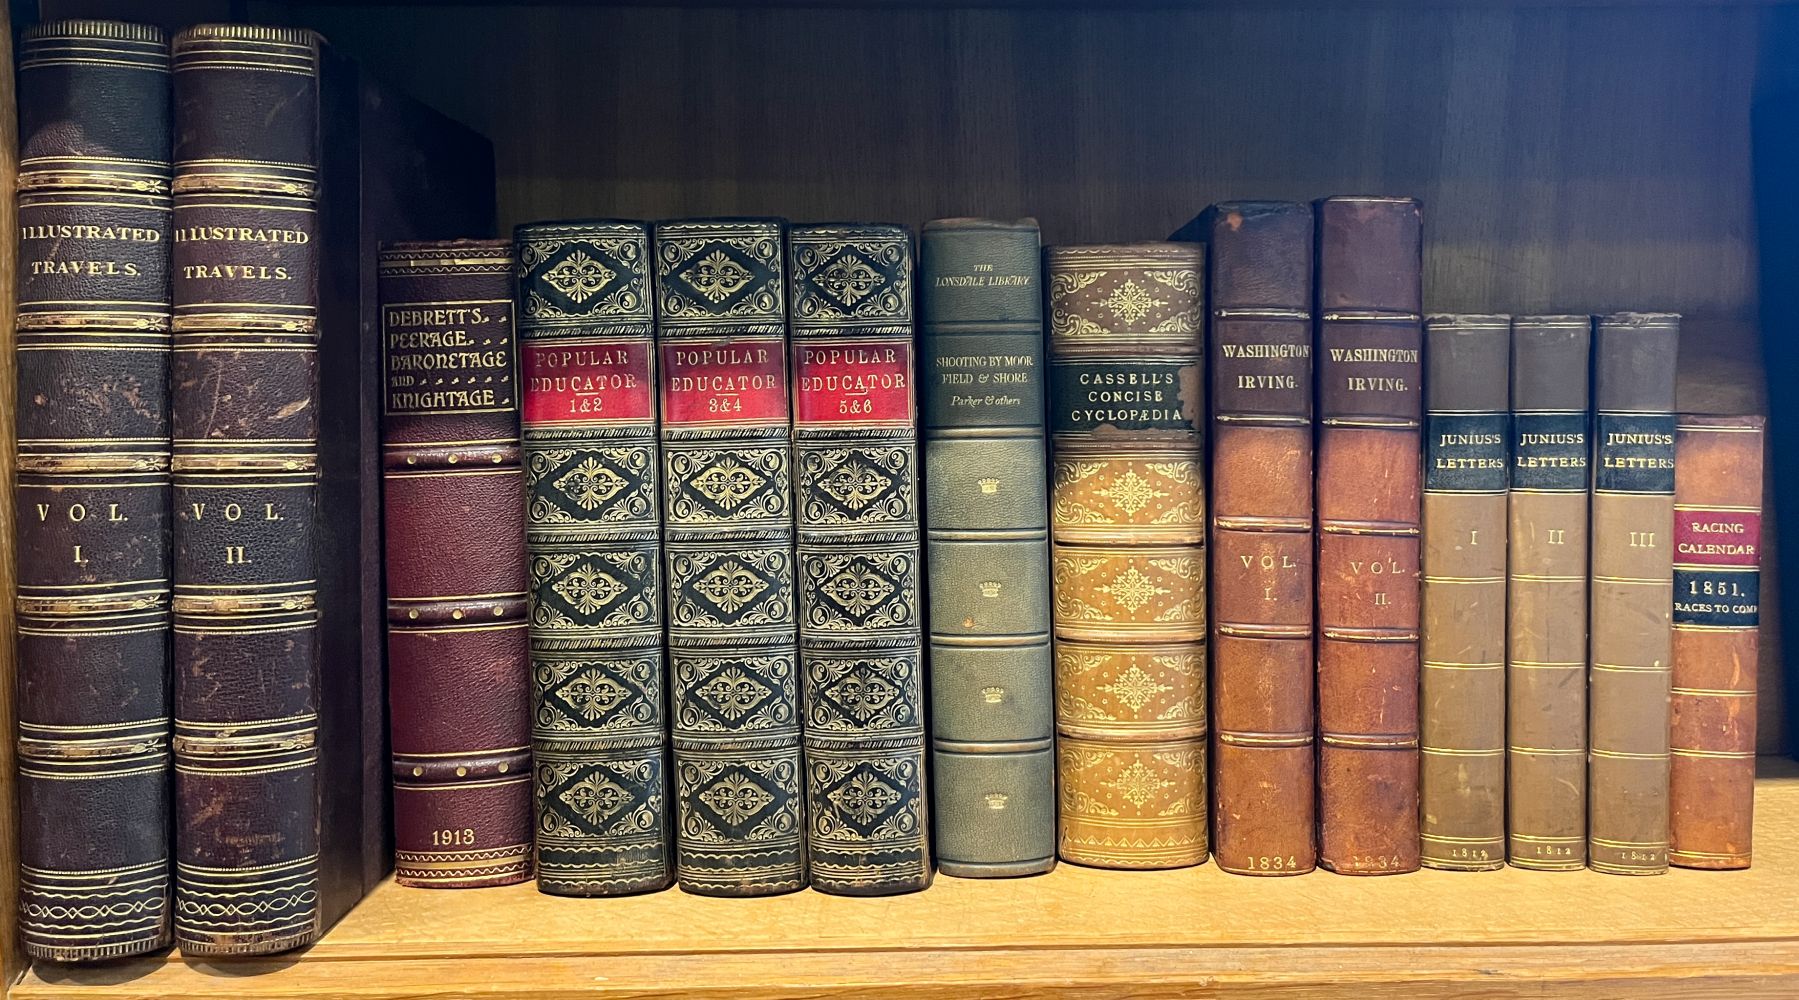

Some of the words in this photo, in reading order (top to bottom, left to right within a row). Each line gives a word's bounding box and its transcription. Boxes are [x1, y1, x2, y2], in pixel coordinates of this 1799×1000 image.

[22, 224, 161, 243] ILLUSTRATED
[175, 225, 310, 244] ILLUSTRATED
[31, 260, 142, 277] TRAVELS.
[183, 265, 292, 281] TRAVELS.
[973, 264, 994, 272] THE
[935, 275, 985, 287] LONSDALE
[988, 275, 1031, 287] LIBRARY
[389, 307, 482, 327] DEBRETT'S
[390, 330, 467, 349] PEERAGE
[535, 350, 628, 368] POPULAR
[676, 349, 769, 366] POPULAR
[804, 348, 897, 365] POPULAR
[1222, 344, 1310, 359] WASHINGTON
[1329, 348, 1419, 363] WASHINGTON
[391, 351, 507, 370] BARONETAGE
[936, 355, 987, 368] SHOOTING
[989, 355, 1001, 366] BY
[1004, 355, 1034, 366] MOOR
[391, 375, 415, 388] AND
[530, 373, 637, 392] EDUCATOR
[671, 374, 776, 392] EDUCATOR
[801, 373, 906, 392] EDUCATOR
[942, 373, 974, 384] FIELD
[978, 373, 989, 383] &
[993, 372, 1028, 383] SHORE
[1079, 373, 1174, 385] CASSELL'S
[1237, 375, 1299, 389] IRVING.
[1347, 377, 1409, 392] IRVING.
[392, 389, 495, 409] KNIGHTAGE
[951, 395, 983, 408] Parker
[985, 395, 994, 406] &
[995, 395, 1021, 406] others
[1088, 390, 1163, 402] CONCISE
[569, 397, 603, 413] 1&2
[708, 398, 742, 413] 3&4
[839, 398, 872, 414] 5&6
[1071, 409, 1182, 422] CYCLOPÆDIA
[1439, 433, 1502, 447] JUNIUS'S
[1519, 433, 1585, 447] JUNIUS'S
[1606, 432, 1673, 446] JUNIUS'S
[1436, 458, 1504, 469] LETTERS
[1516, 456, 1586, 468] LETTERS
[1604, 457, 1674, 469] LETTERS
[37, 503, 129, 522] VOL.
[192, 503, 285, 522] VOL.
[1691, 522, 1745, 534] RACING
[1470, 530, 1478, 545] I
[1548, 529, 1565, 545] II
[1629, 532, 1656, 547] III
[73, 545, 89, 564] I.
[225, 546, 252, 565] II.
[1677, 543, 1755, 555] CALENDAR
[1240, 555, 1297, 569] VOL.
[1350, 561, 1406, 575] VOL.
[1689, 580, 1745, 597] 1851.
[1674, 602, 1712, 613] RACES
[1714, 604, 1730, 613] TO
[432, 828, 475, 845] 1913
[1536, 844, 1571, 855] 1812
[1247, 855, 1297, 870] 1834
